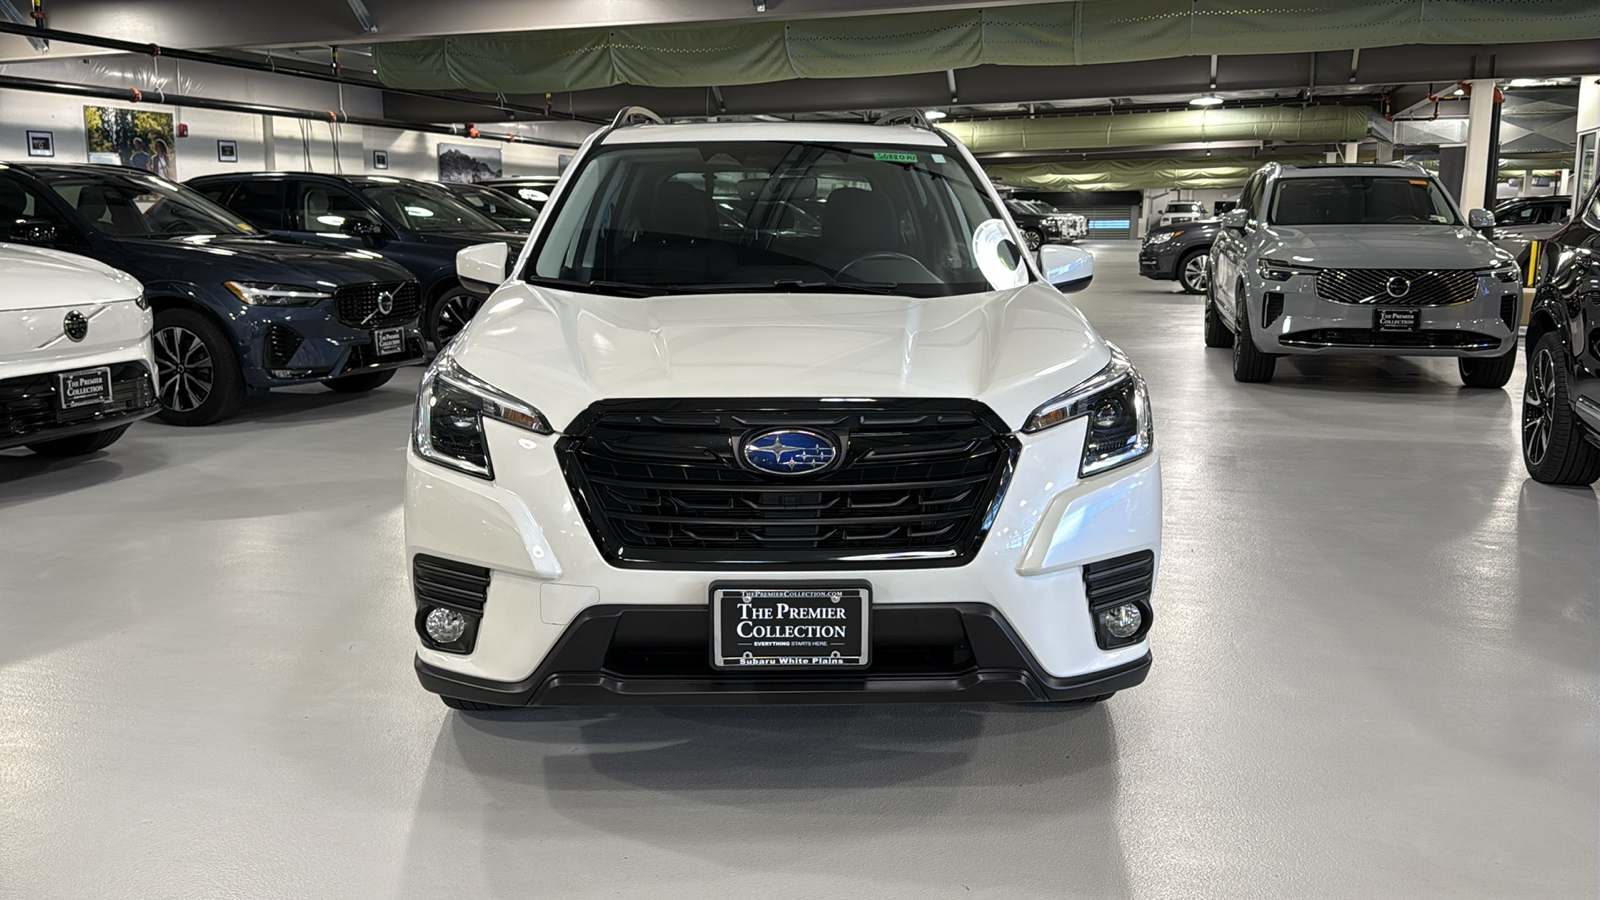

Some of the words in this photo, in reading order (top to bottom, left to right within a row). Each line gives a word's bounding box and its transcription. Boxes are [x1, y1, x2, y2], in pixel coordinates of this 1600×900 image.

[67, 380, 79, 389] THE
[79, 377, 103, 387] PREMIER
[67, 384, 104, 397] COLLECTION
[737, 603, 773, 619] THE
[776, 603, 846, 619] PREMIER
[736, 621, 846, 638] COLLECTION
